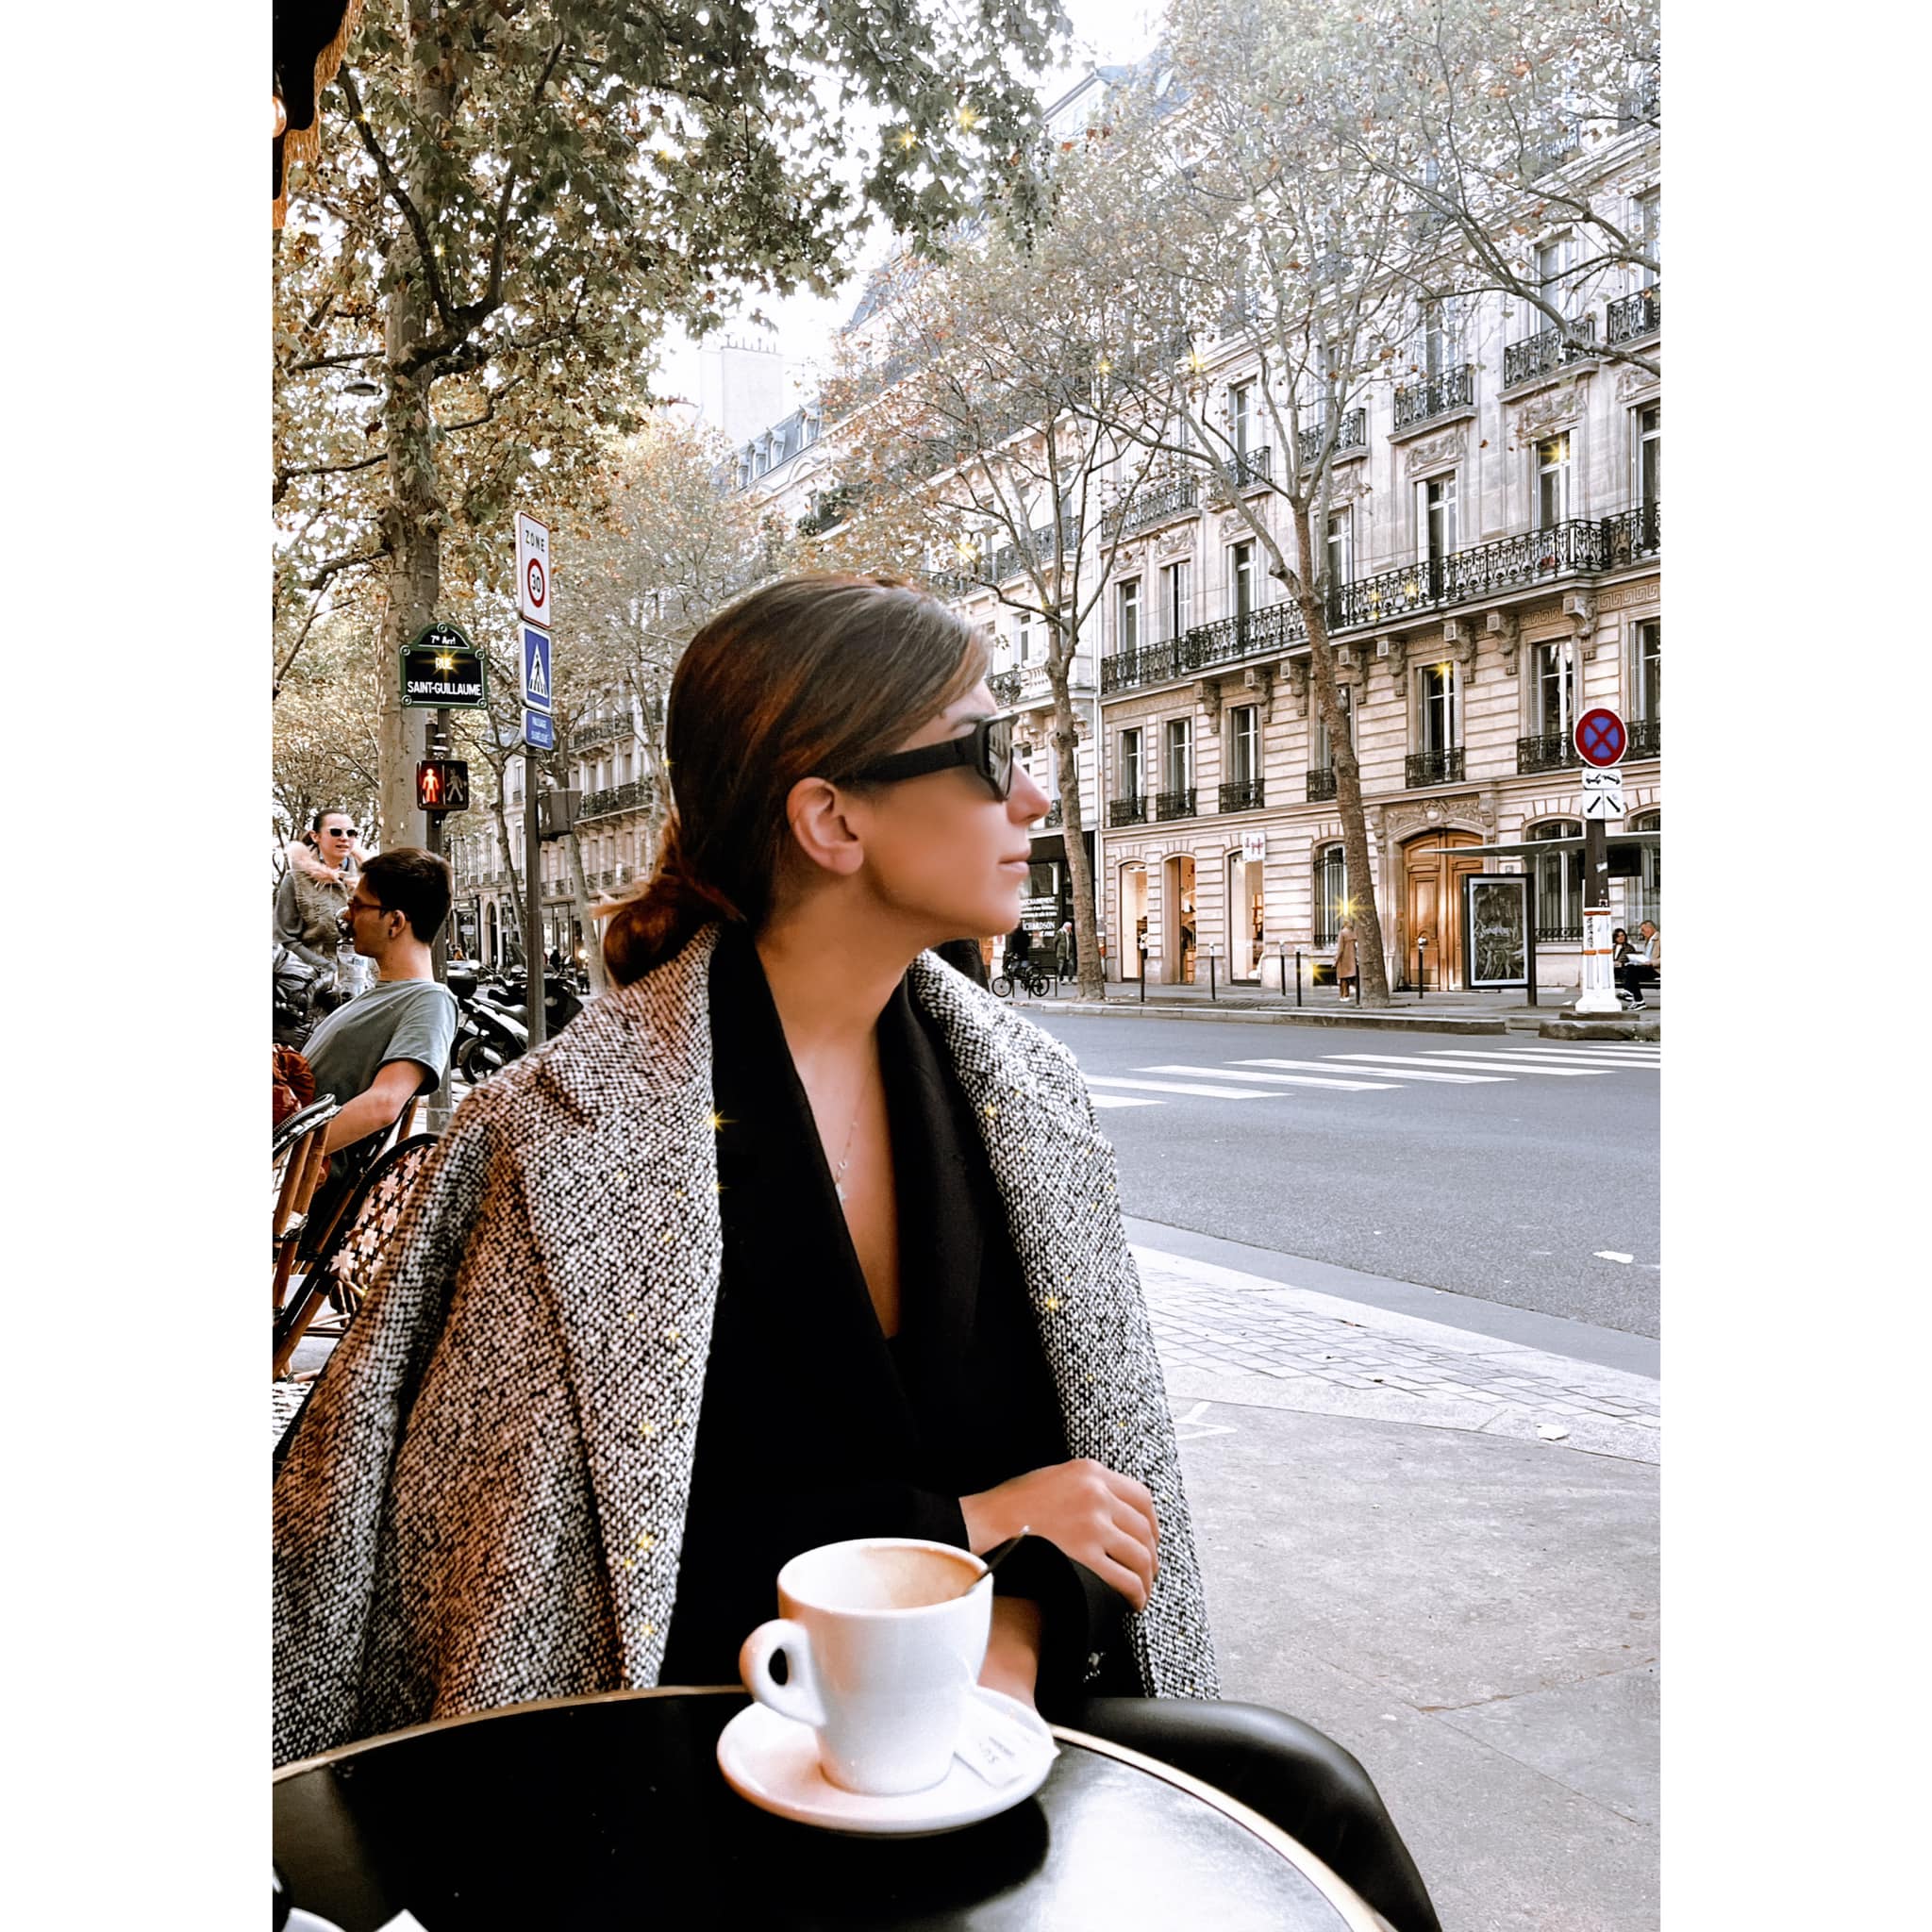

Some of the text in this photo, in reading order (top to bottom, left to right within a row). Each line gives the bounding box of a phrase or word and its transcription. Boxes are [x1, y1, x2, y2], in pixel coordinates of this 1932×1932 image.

[525, 529, 545, 553] ZONE
[531, 574, 541, 593] 30
[435, 657, 454, 670] RUE
[407, 680, 483, 696] SAINT-GUILLAUME
